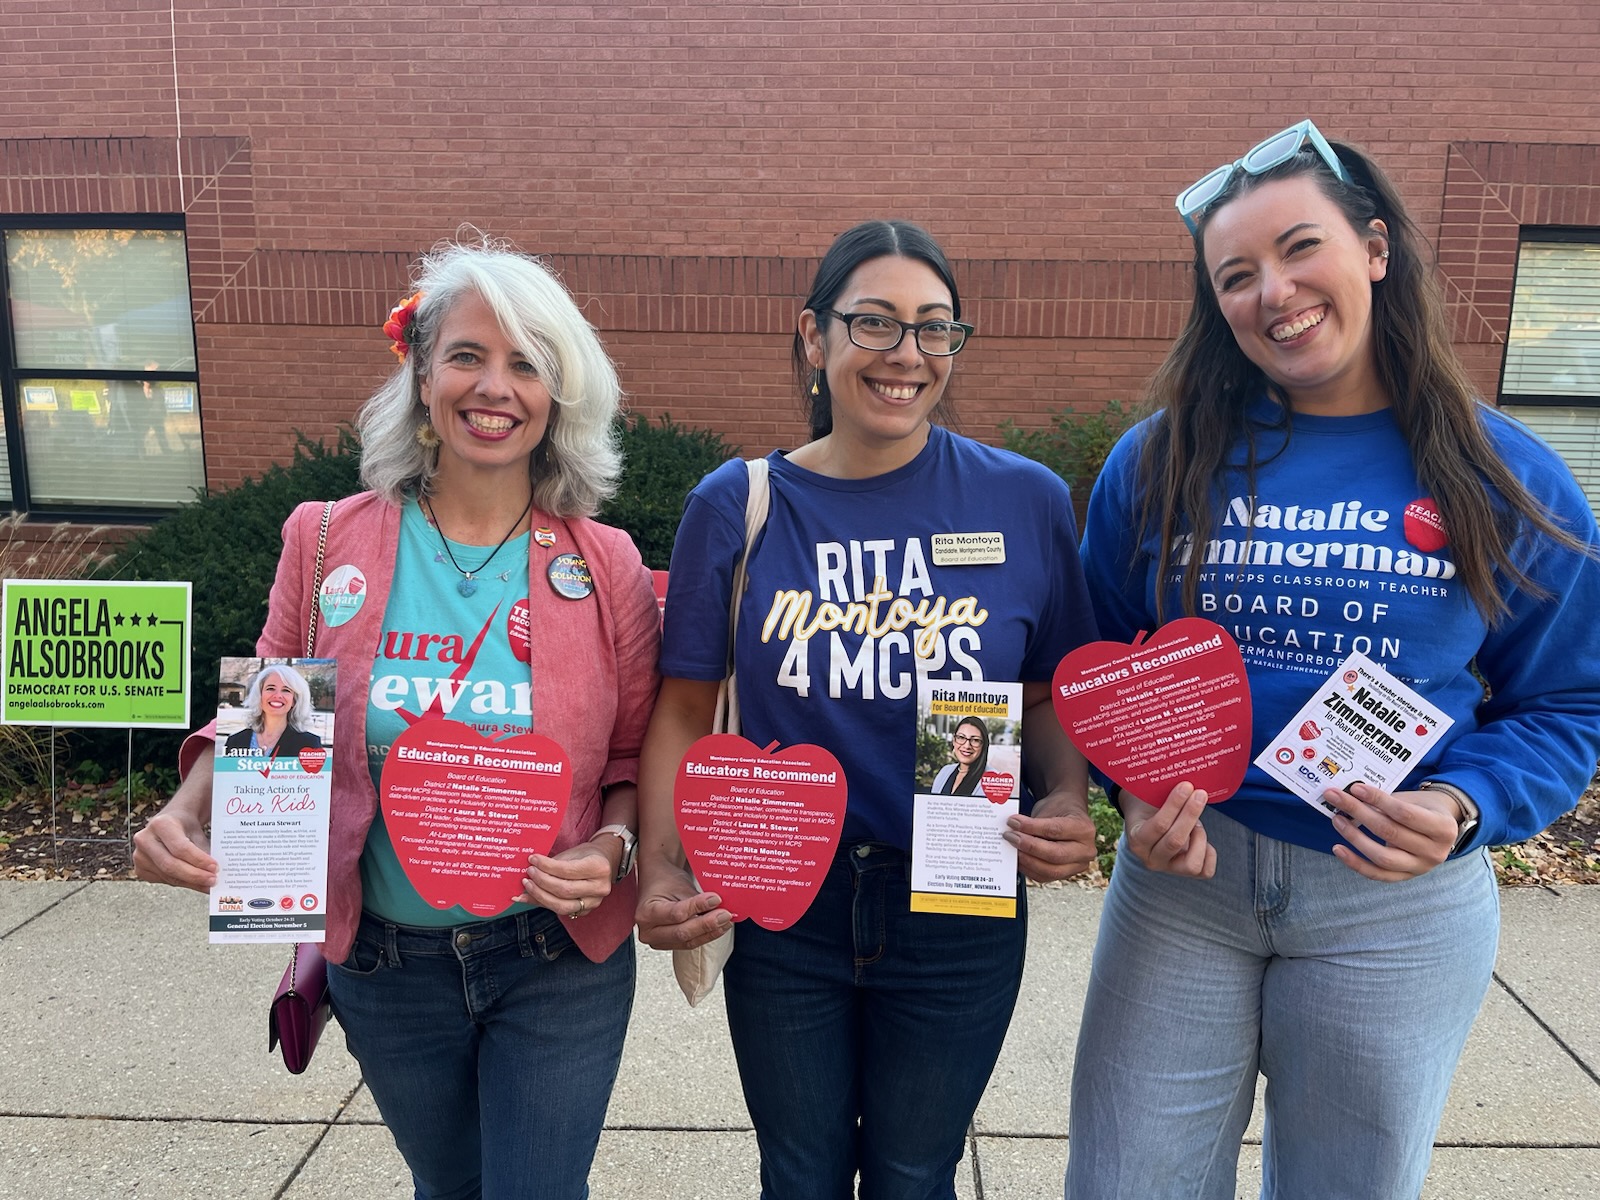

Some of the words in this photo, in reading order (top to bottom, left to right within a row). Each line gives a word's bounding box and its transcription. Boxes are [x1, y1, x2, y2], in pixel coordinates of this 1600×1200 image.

[1223, 495, 1389, 532] Natalie
[957, 536, 1000, 544] Montoya
[557, 557, 586, 568] YOUNG
[816, 537, 934, 603] RITA
[551, 572, 591, 583] SOLUTION
[1225, 573, 1265, 584] MCPS
[1273, 574, 1369, 590] CLASSROOM
[1379, 582, 1448, 598] TEACHER
[14, 597, 111, 637] ANGELA
[761, 575, 989, 659] Montoya
[1202, 593, 1319, 618] BOARD
[1343, 601, 1389, 625] OF
[375, 630, 465, 665] ura
[9, 639, 164, 679] ALSOBROOKS
[776, 639, 811, 697] 4
[829, 626, 983, 700] MCPS
[1060, 668, 1130, 697] Educators
[1131, 634, 1222, 674] Recommend
[1253, 660, 1283, 670] NATALIE
[1286, 665, 1329, 675] ZIMMERMAN
[9, 684, 70, 695] DEMOCRAT
[74, 685, 96, 696] FOR
[100, 685, 121, 696] U.S.
[125, 686, 164, 697] SENATE
[1099, 700, 1121, 712] District
[1126, 691, 1154, 703] Natalie
[1154, 676, 1201, 694] Zimmerman
[1116, 685, 1136, 696] Board
[1136, 682, 1143, 690] of
[1143, 673, 1175, 688] Education
[9, 700, 105, 709] angelaalsobrooks.com
[932, 689, 956, 701] Rita
[959, 691, 1008, 706] Montoya
[1357, 667, 1375, 683] There's
[1378, 683, 1397, 698] teacher
[1396, 696, 1418, 714] shortage
[1417, 710, 1424, 718] in
[1422, 715, 1437, 727] MCPS.
[944, 704, 963, 712] Board
[974, 706, 1006, 714] Education
[1113, 722, 1135, 733] District
[1140, 714, 1163, 725] Laura
[1174, 700, 1205, 714] Stewart
[1351, 686, 1406, 733] Natalie
[470, 721, 499, 732] aura
[1323, 691, 1412, 762] Zimmerman
[1130, 741, 1157, 753] At-Large
[1156, 737, 1173, 745] Rita
[1173, 726, 1207, 740] Montoya
[1324, 710, 1336, 722] for
[1334, 718, 1357, 737] Board
[1354, 734, 1365, 742] of
[1361, 738, 1393, 765] Education
[222, 746, 263, 757] Laura
[398, 746, 470, 764] Educators
[473, 754, 562, 773] Recommend
[237, 759, 298, 771] Stewart
[686, 762, 750, 777] Educators
[753, 766, 836, 783] Recommend
[424, 780, 446, 788] District
[452, 783, 480, 792] Natalie
[481, 786, 527, 796] Zimmerman
[447, 772, 467, 780] Board
[475, 775, 507, 784] Education
[234, 785, 265, 796] Taking
[267, 785, 295, 794] Action
[297, 785, 310, 793] for
[710, 794, 730, 802] District
[735, 796, 761, 804] Natalie
[762, 798, 805, 807] Zimmerman
[730, 786, 748, 794] Board
[756, 788, 785, 796] Education
[226, 797, 264, 815] Our
[271, 793, 316, 813] Kids
[425, 805, 447, 813] District
[453, 808, 476, 816] Laura
[488, 811, 519, 820] Stewart
[712, 819, 733, 827] District
[738, 821, 758, 829] Laura
[770, 824, 799, 832] Stewart
[428, 830, 457, 840] At-Large
[457, 833, 473, 841] Rita
[475, 835, 508, 844] Montoya
[743, 846, 758, 854] Rita
[760, 848, 790, 857] Montoya
